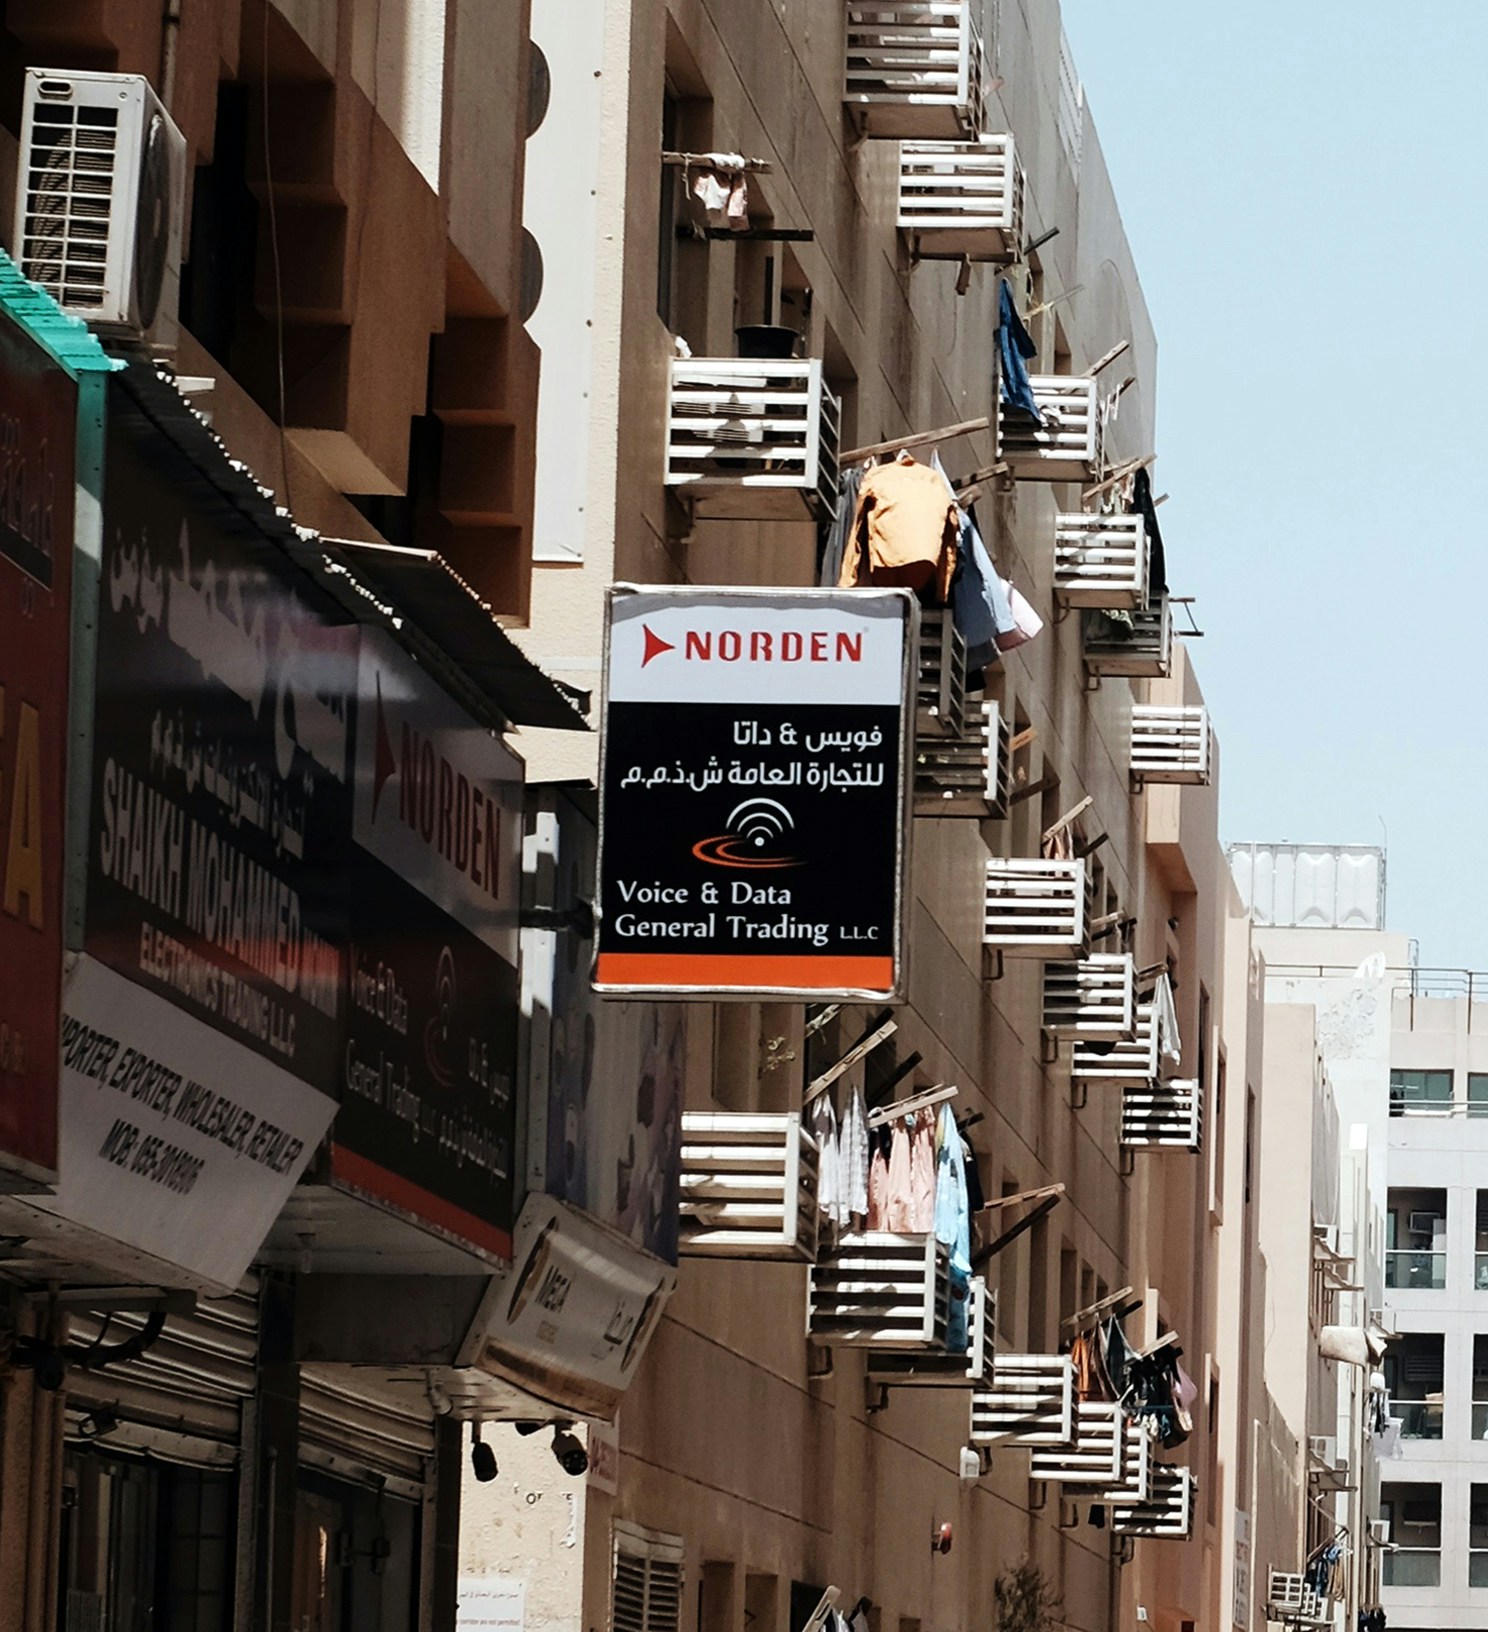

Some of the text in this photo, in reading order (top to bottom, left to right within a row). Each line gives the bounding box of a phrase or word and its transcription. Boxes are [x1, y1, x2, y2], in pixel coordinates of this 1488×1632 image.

[685, 630, 863, 663] NORDEN
[733, 721, 882, 752] فويس & داتا
[727, 760, 802, 785] العامة
[806, 761, 884, 793] للتجارة
[400, 720, 501, 900] NORDEN
[101, 757, 185, 920] SHAIKH
[187, 818, 302, 994] MOHAMMED
[616, 879, 791, 905] Voice & Data
[614, 913, 715, 939] General
[726, 915, 829, 946] Trading
[246, 1120, 304, 1176] RETAILER
